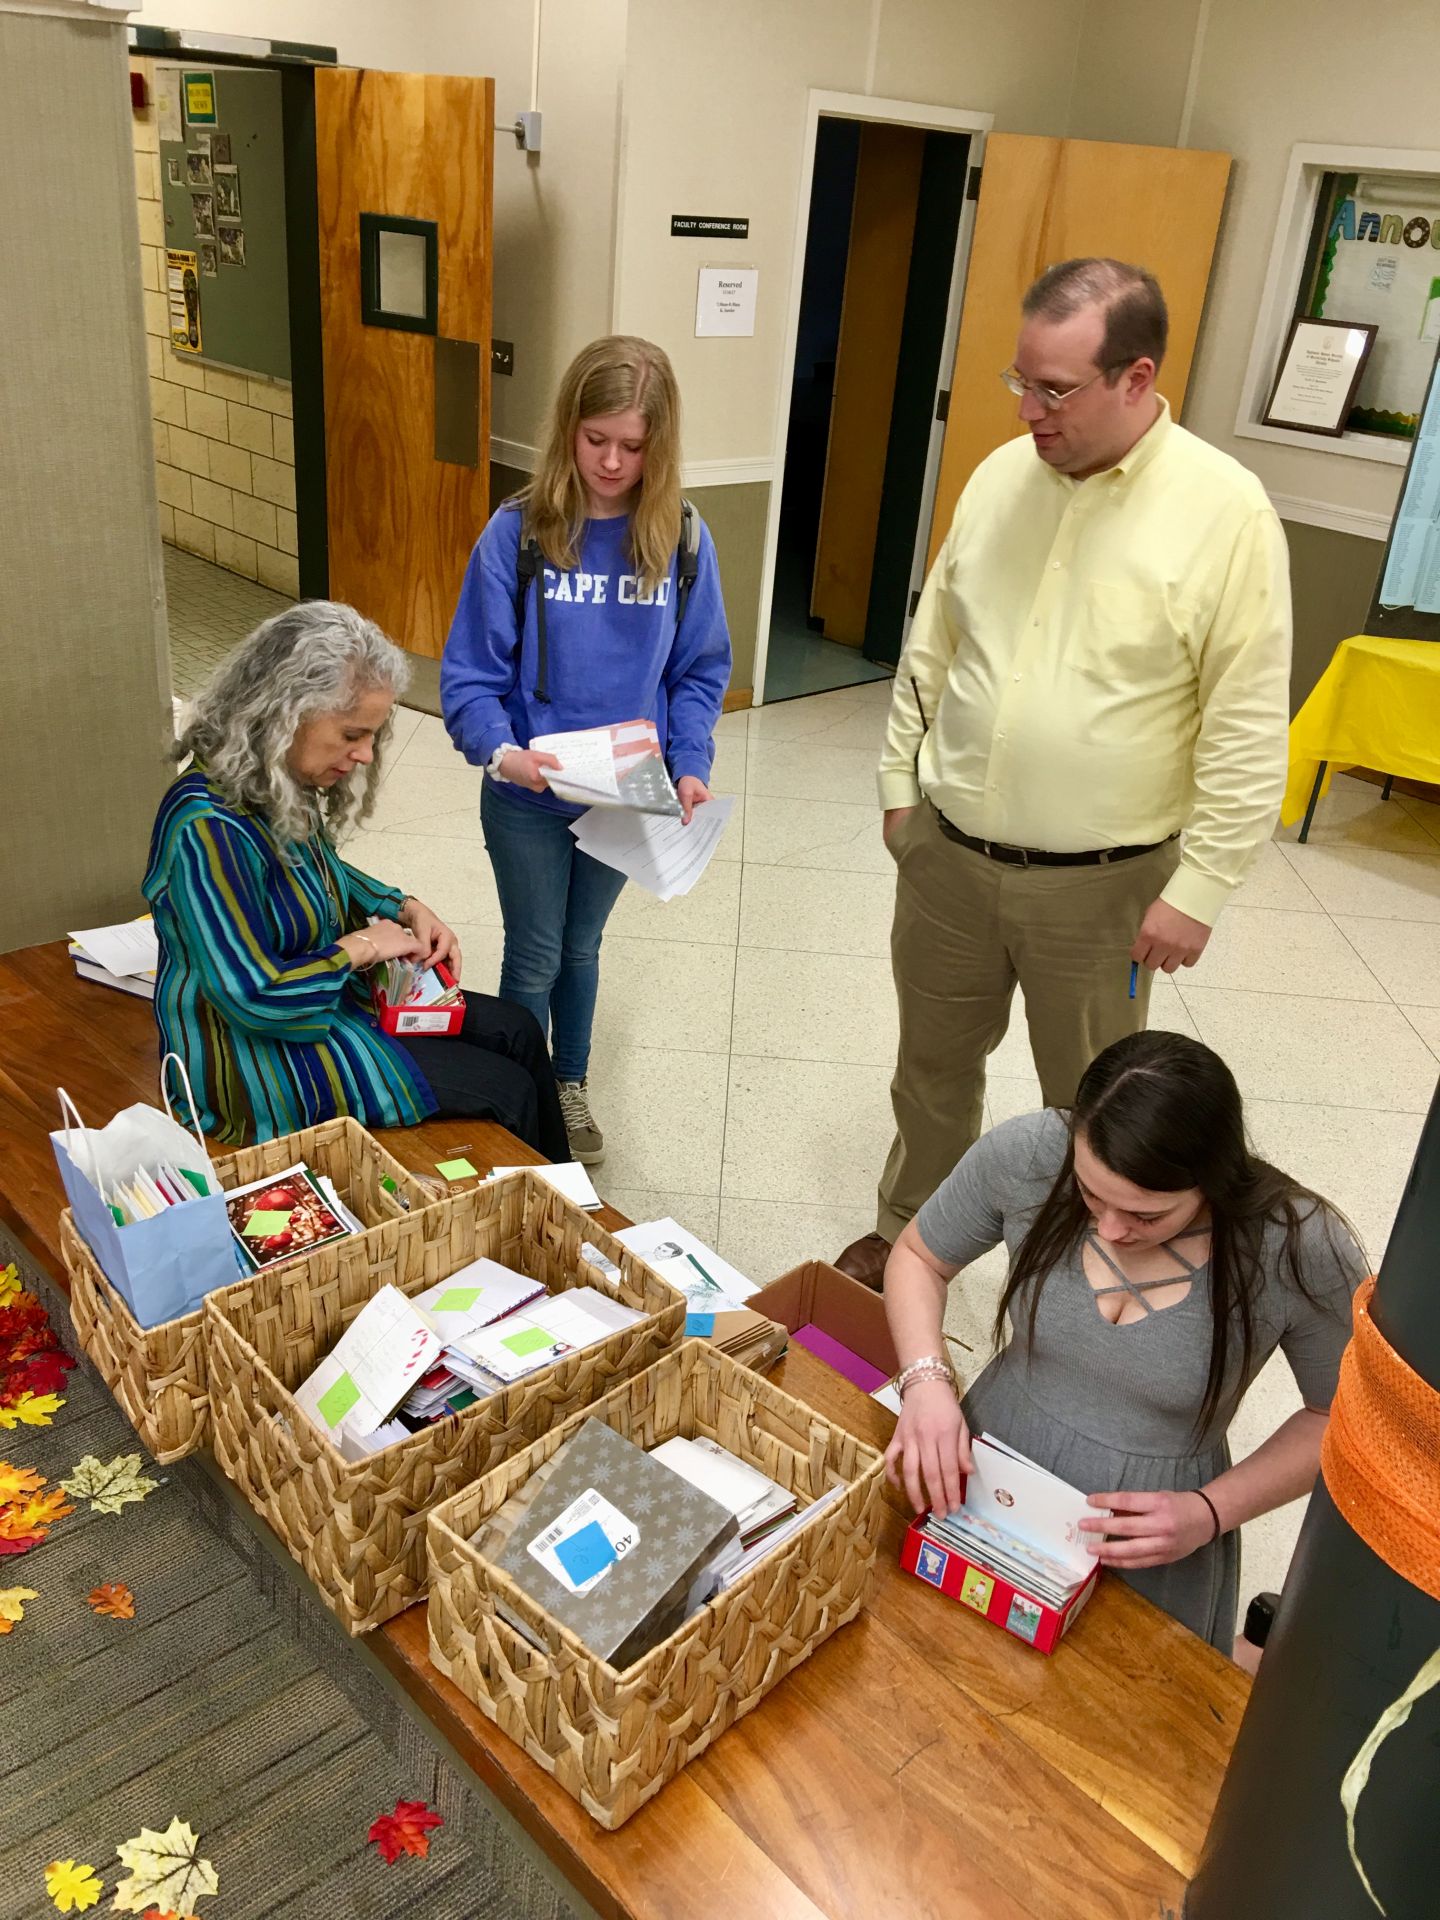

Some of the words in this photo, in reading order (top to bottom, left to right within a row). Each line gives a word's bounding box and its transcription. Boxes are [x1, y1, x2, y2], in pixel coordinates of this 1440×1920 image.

[673, 220, 697, 228] FACULTY
[698, 222, 731, 230] CONFERENCE
[732, 223, 748, 231] ROOM
[718, 280, 743, 288] Reserved
[543, 568, 609, 604] CAPE
[615, 1535, 632, 1552] 40
